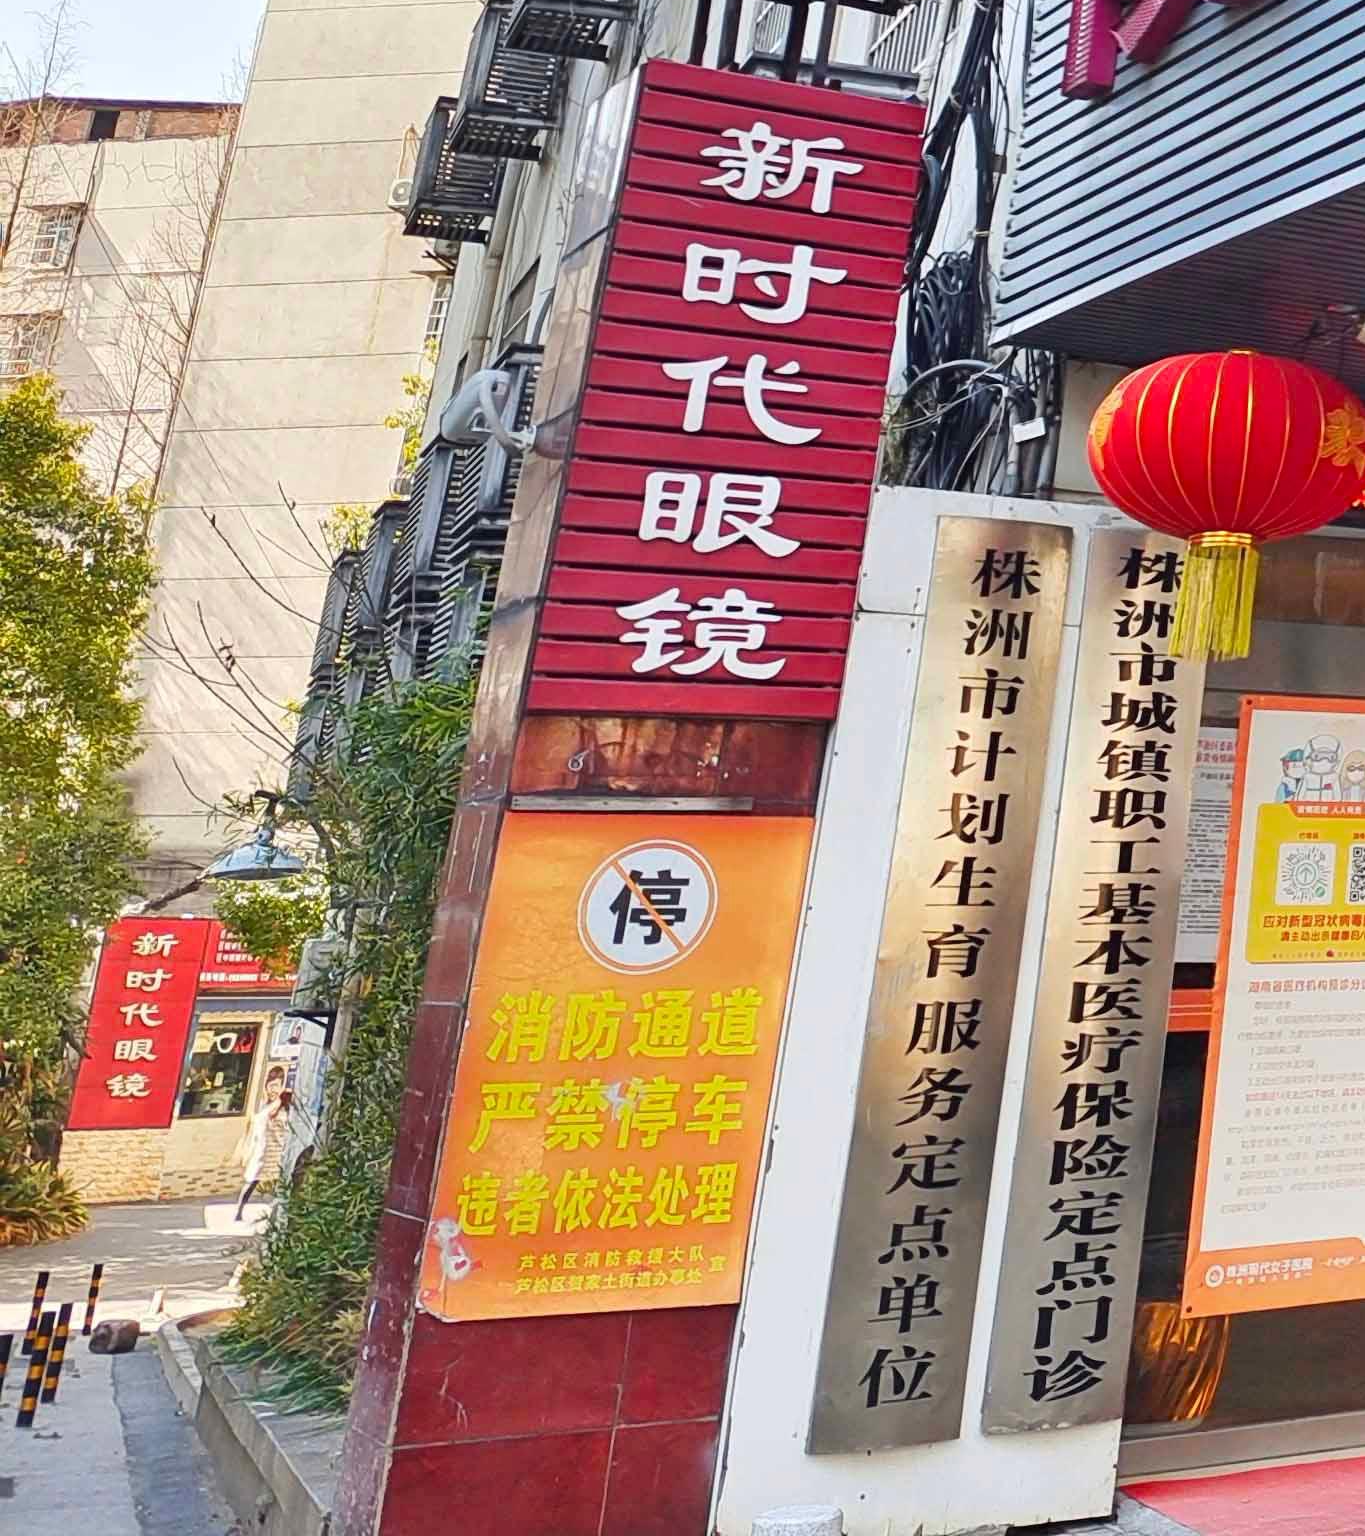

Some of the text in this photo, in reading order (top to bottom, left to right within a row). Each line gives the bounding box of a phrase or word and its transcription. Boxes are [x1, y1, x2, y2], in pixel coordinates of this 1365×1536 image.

[615, 121, 864, 680] 新时代眼镜
[608, 868, 690, 946] 停
[106, 931, 180, 1099] 新时代眼镜
[486, 986, 764, 1063] 消防通道
[858, 548, 1042, 1409] 株洲市计划生育服务定点单位
[1023, 547, 1185, 1403] 株洲市城镇职工基本医疗保险定点门诊
[468, 1072, 750, 1153] 严禁停车
[456, 1161, 738, 1236] 违者依法处理
